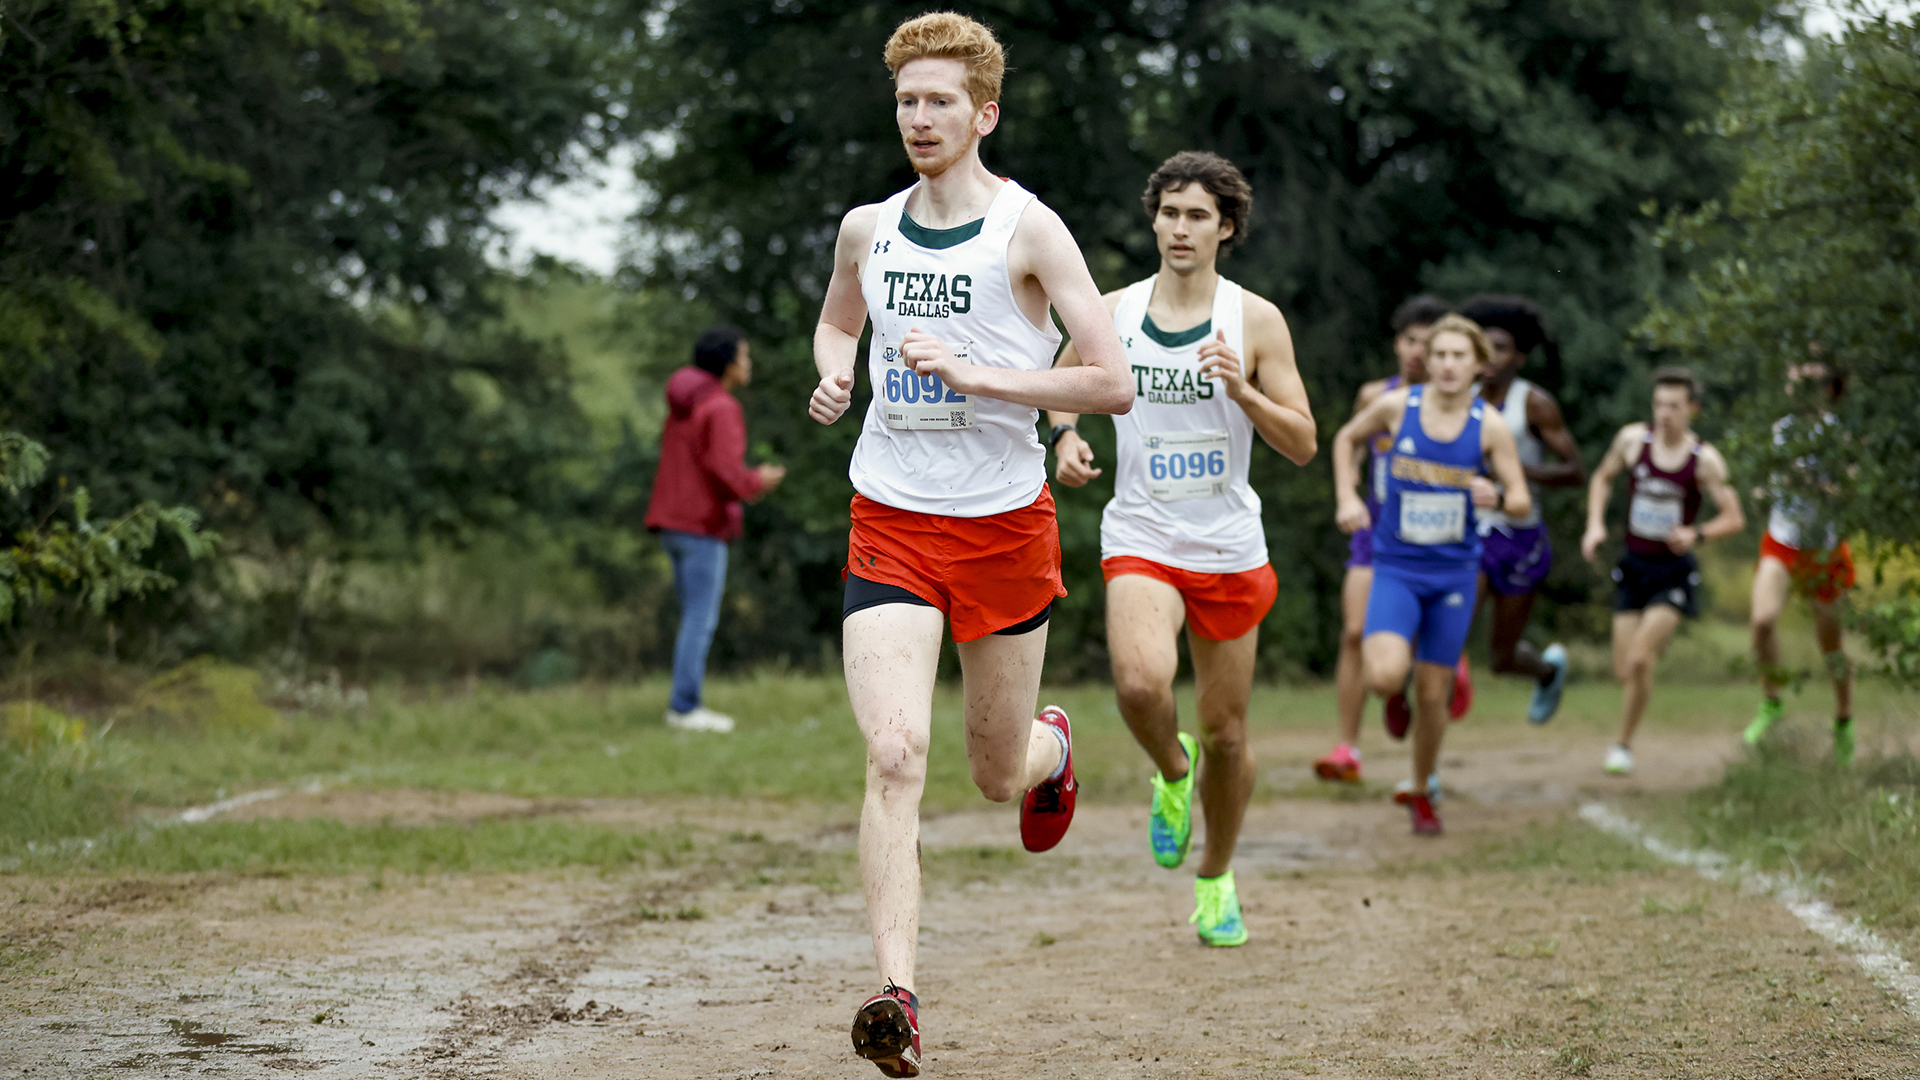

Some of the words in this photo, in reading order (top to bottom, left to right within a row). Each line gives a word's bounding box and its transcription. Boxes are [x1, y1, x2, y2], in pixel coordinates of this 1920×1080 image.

[884, 271, 972, 314] TEXAS
[898, 302, 950, 319] DALLAS
[1131, 365, 1214, 400] TEXAS
[1148, 391, 1197, 405] DALLAS
[1150, 450, 1225, 480] 6096
